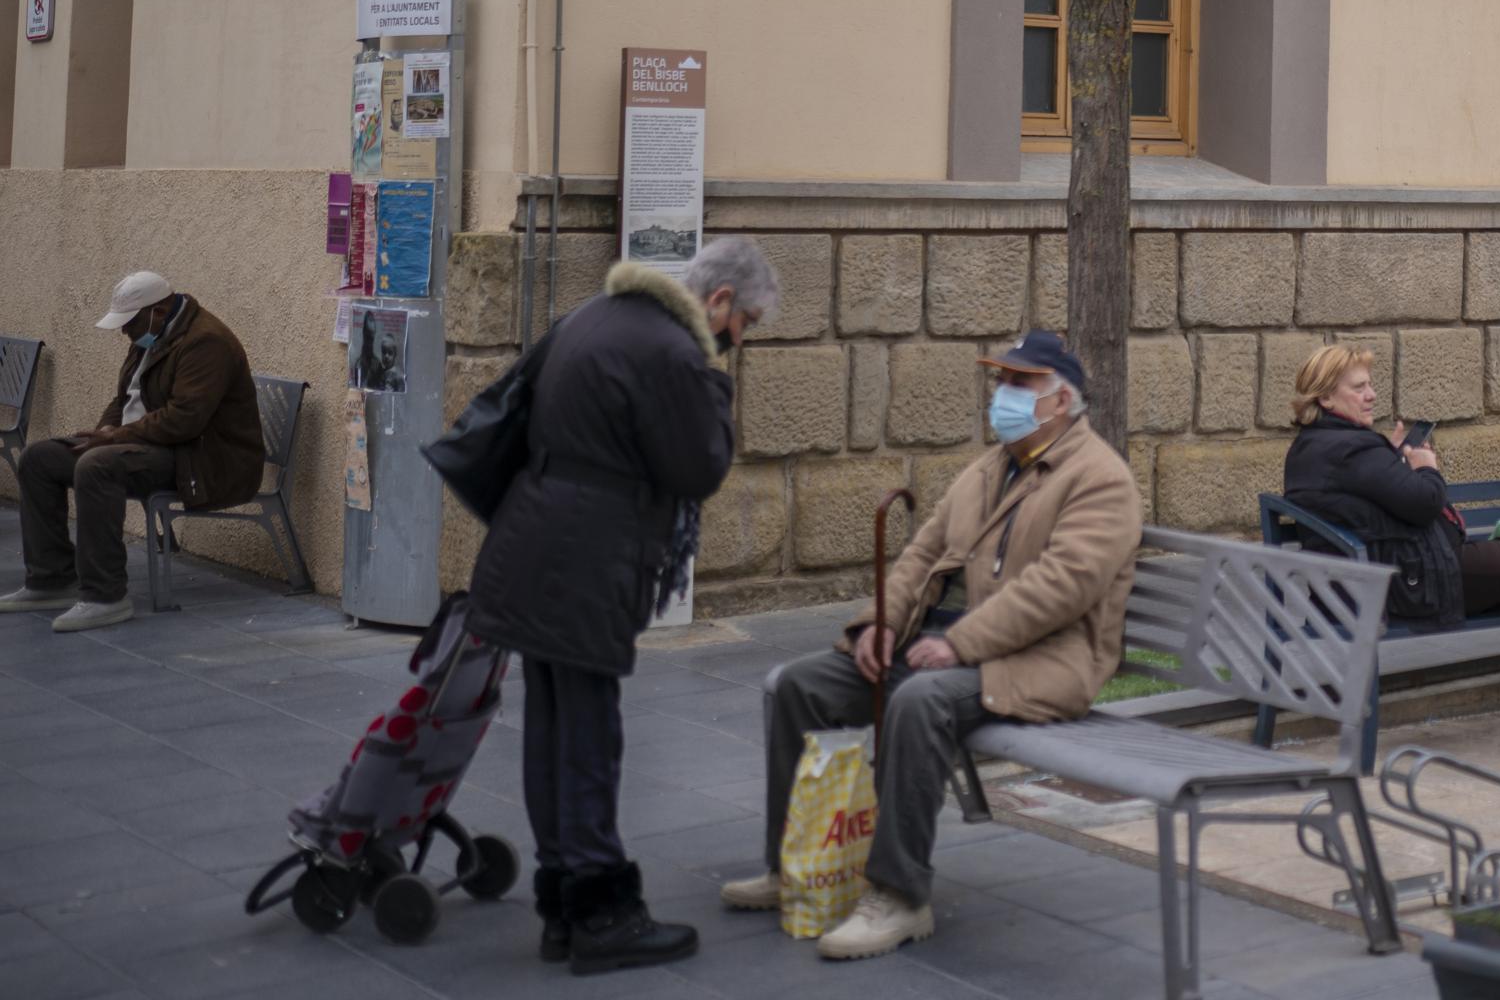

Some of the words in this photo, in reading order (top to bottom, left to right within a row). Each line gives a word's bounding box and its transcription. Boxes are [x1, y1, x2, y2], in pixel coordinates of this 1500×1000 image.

[380, 17, 408, 28] ENTITATS
[409, 16, 440, 26] LOCALS
[633, 56, 666, 71] PLAÇA
[632, 69, 653, 80] DEL
[656, 69, 687, 81] BISBE
[632, 81, 688, 93] BENLLOCH
